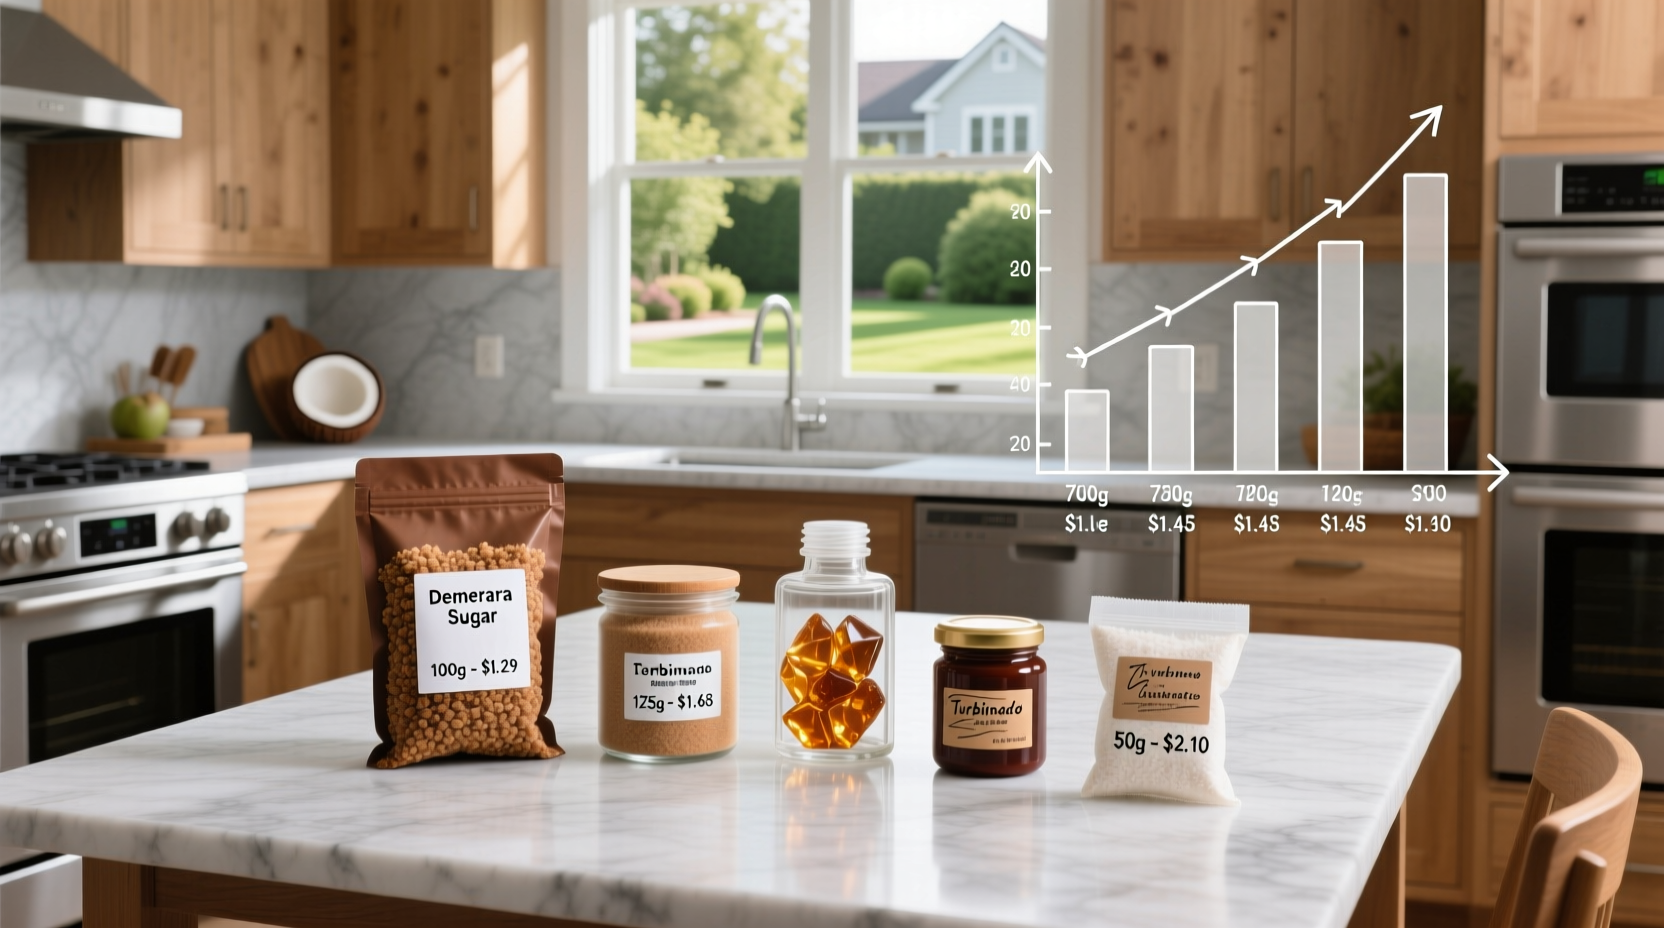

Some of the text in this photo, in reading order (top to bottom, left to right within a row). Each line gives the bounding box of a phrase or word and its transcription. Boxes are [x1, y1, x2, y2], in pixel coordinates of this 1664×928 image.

[429, 589, 513, 606] Demerara
[448, 608, 498, 629] Sugar
[430, 662, 467, 681] 100g
[481, 658, 518, 677] $1.29
[677, 693, 714, 710] $1.68
[1113, 730, 1146, 756] 50g
[1163, 732, 1210, 754] $2.10
